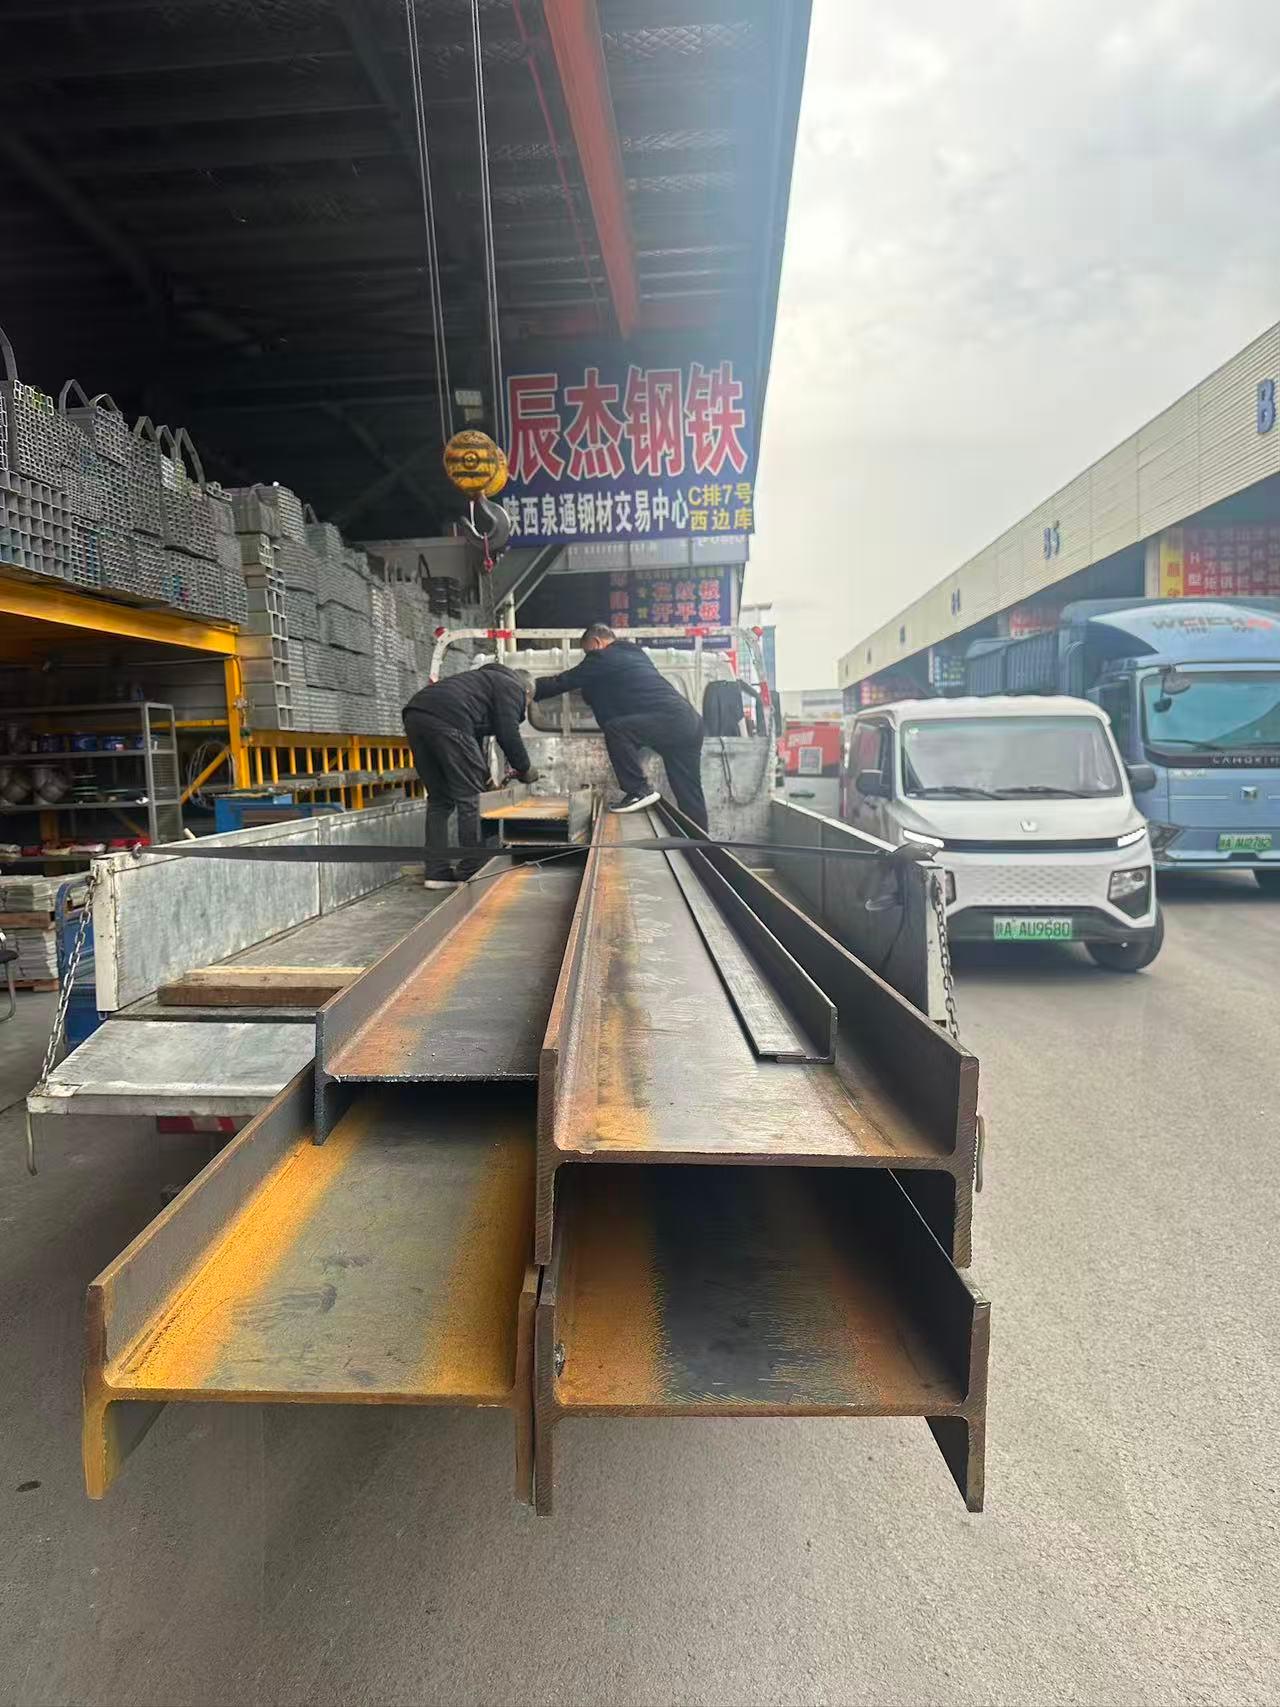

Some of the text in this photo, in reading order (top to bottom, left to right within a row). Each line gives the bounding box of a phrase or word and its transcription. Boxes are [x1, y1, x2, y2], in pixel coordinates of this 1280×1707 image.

[505, 361, 748, 484] 辰杰钢铁
[503, 488, 689, 536] 陕西泉通钢材交易中心
[688, 482, 752, 506] C排7号
[690, 508, 753, 532] 西边库
